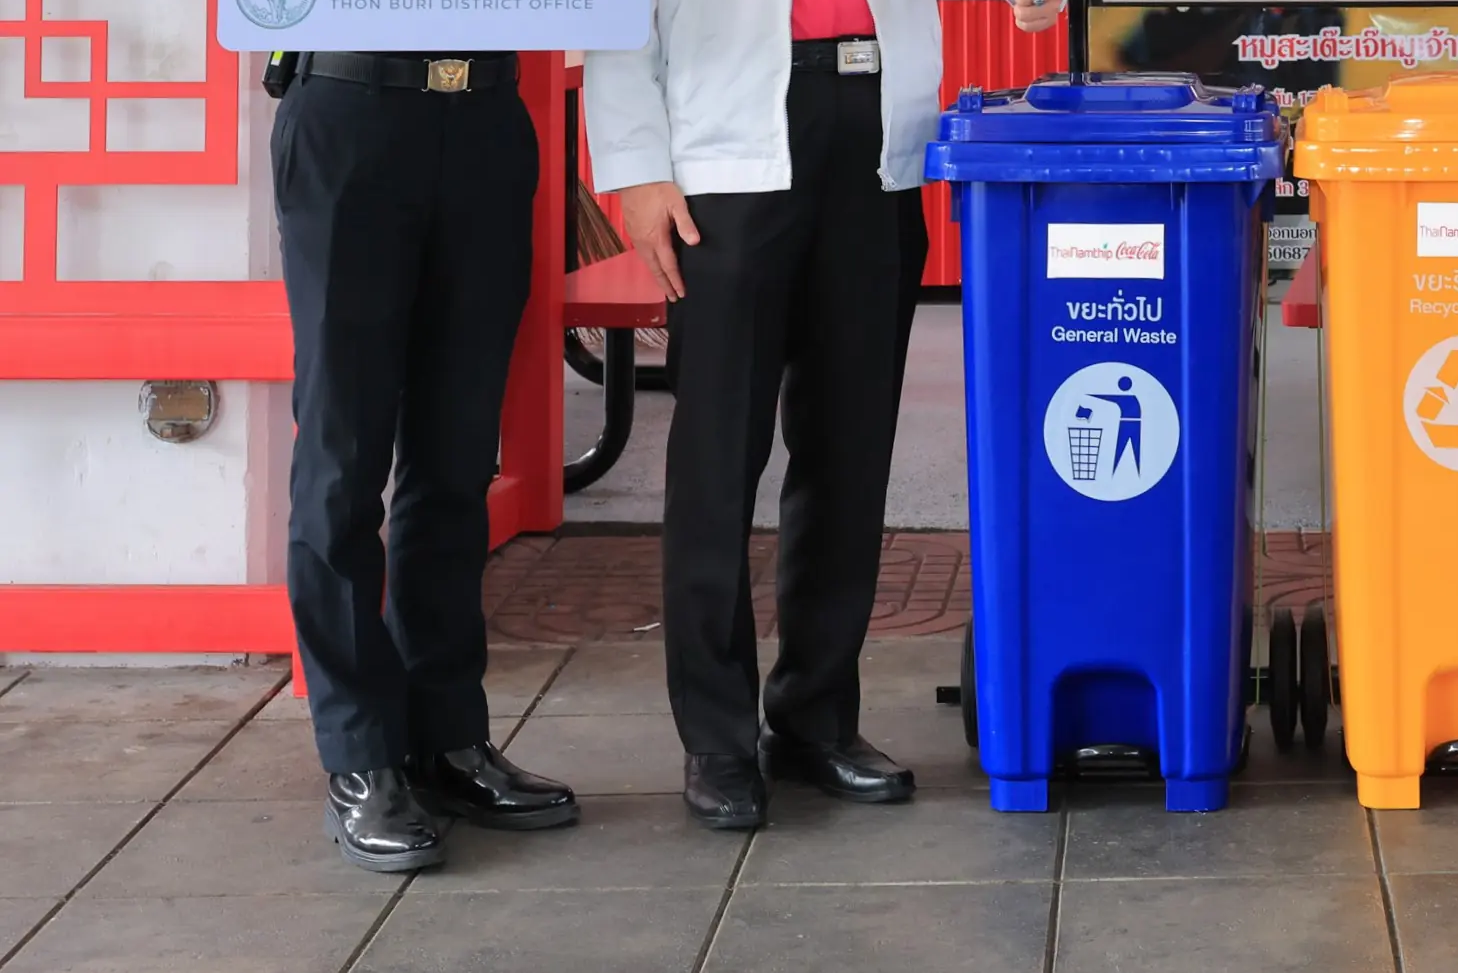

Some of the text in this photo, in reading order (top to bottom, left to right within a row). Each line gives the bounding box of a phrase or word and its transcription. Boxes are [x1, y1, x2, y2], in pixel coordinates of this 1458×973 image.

[1050, 241, 1161, 261] ThaiNamthip Coca-Cola
[1066, 289, 1163, 322] ขยะทั่วไป
[1051, 326, 1177, 344] General Waste
